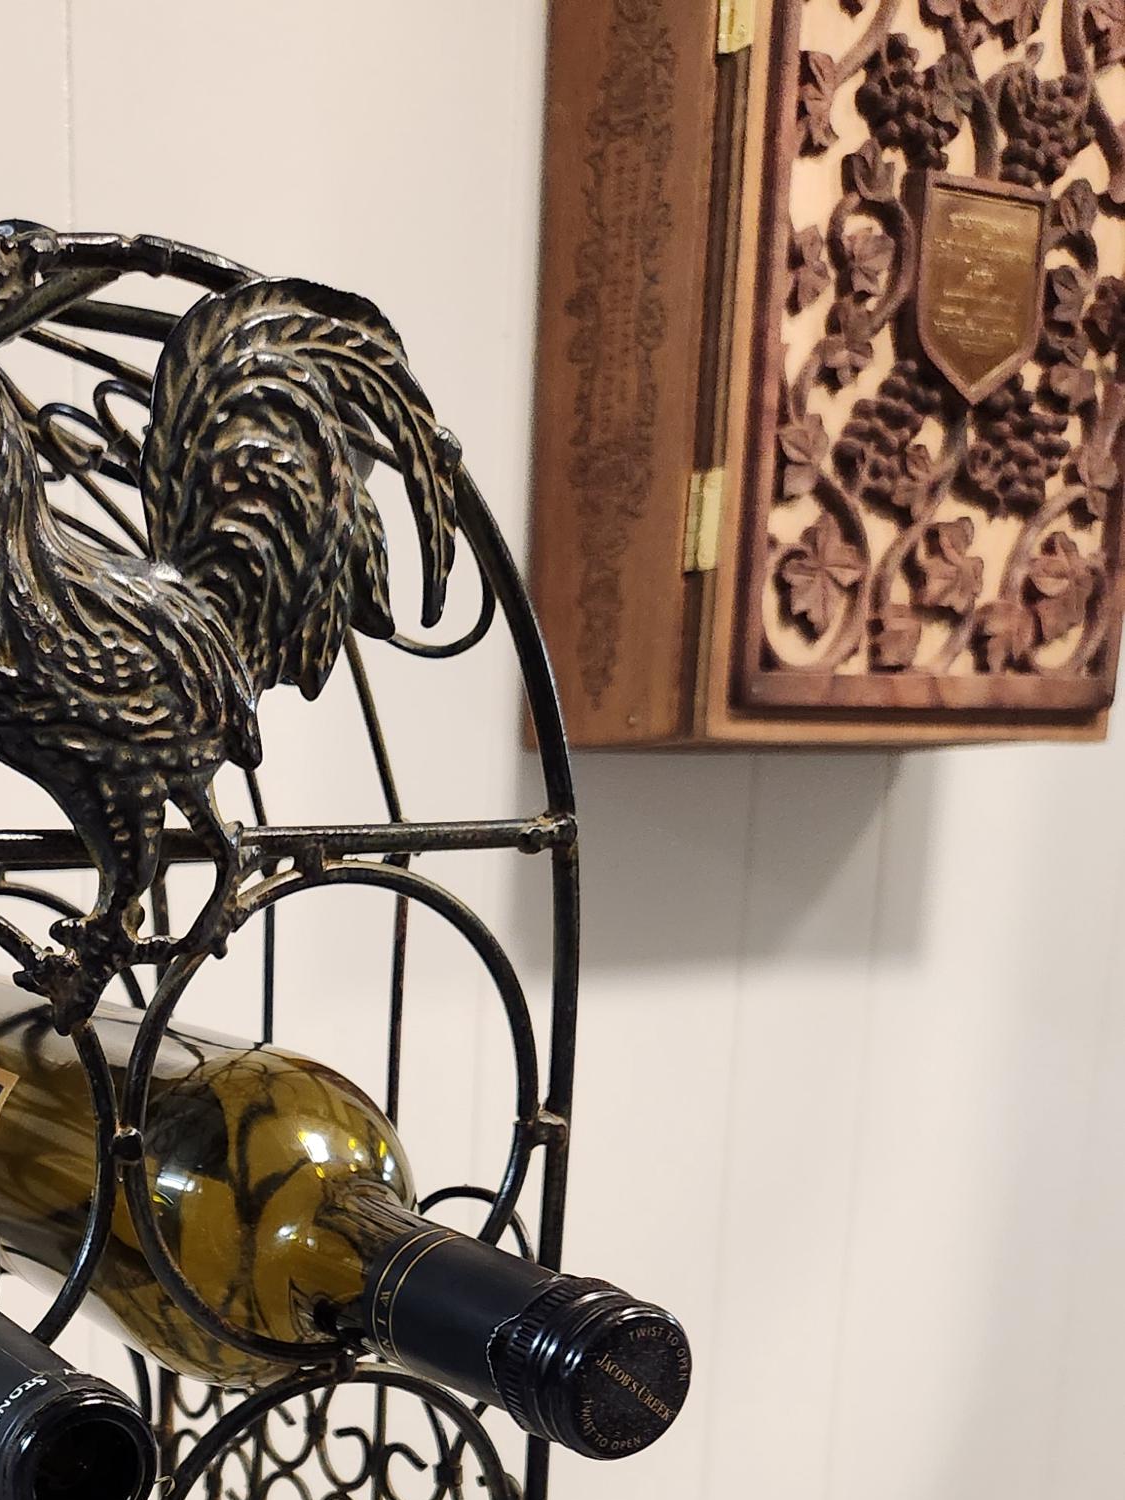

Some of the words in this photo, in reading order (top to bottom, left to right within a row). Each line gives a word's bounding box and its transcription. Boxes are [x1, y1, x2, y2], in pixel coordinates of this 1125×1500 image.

[629, 1325, 664, 1342] TWIST
[666, 1331, 680, 1347] TO
[676, 1347, 691, 1382] OPEN
[596, 1353, 639, 1393] JACOB'S
[637, 1384, 674, 1422] CREEK
[579, 1398, 595, 1433] TWIST
[594, 1432, 609, 1448] TO
[610, 1435, 643, 1450] OPEN
